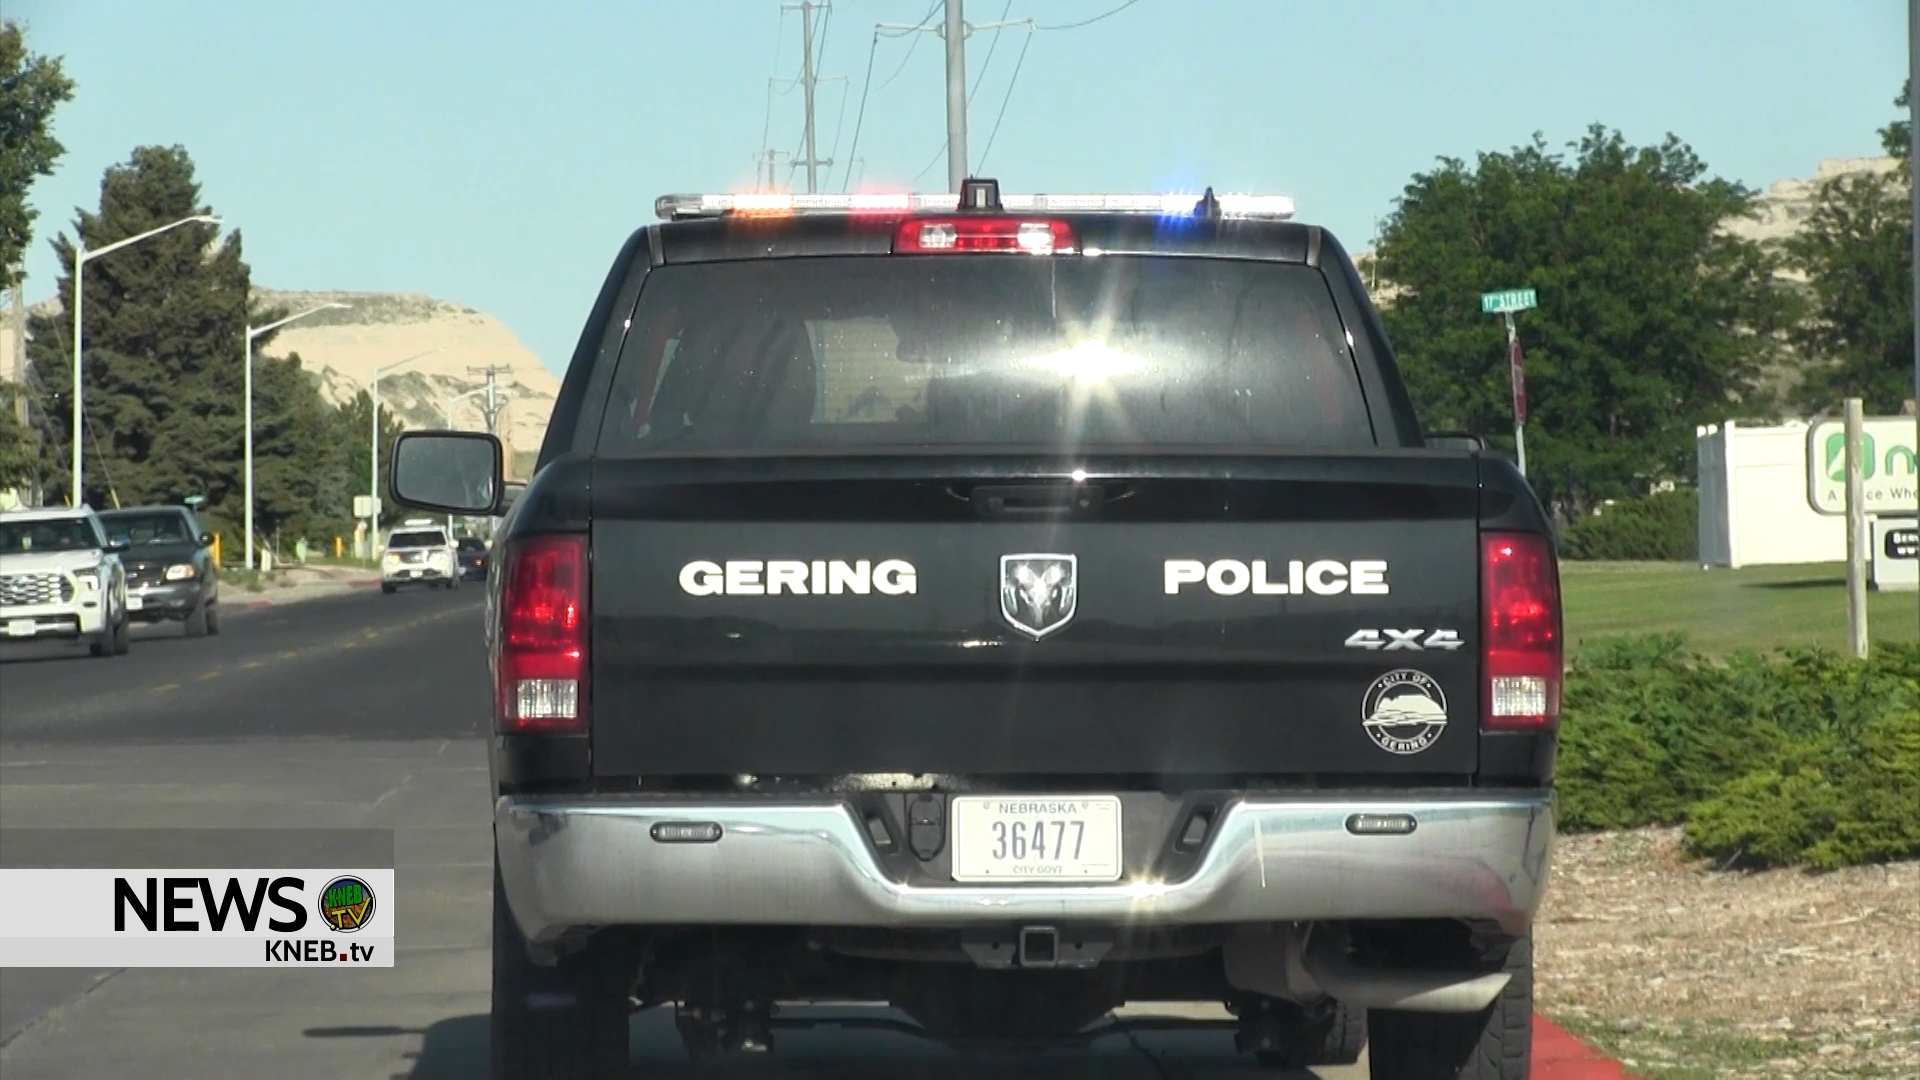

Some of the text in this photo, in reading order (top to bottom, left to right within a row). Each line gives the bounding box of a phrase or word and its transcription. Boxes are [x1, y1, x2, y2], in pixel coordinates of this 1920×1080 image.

[1500, 291, 1535, 307] STREET
[1828, 490, 1837, 501] A
[678, 559, 917, 596] GERING
[1163, 559, 1389, 595] POLICE
[1382, 673, 1428, 687] CITY OF
[1381, 735, 1428, 751] GERING
[999, 803, 1077, 814] NEBRASKA
[992, 820, 1085, 860] 36477
[1013, 865, 1063, 874] CITY GOVT
